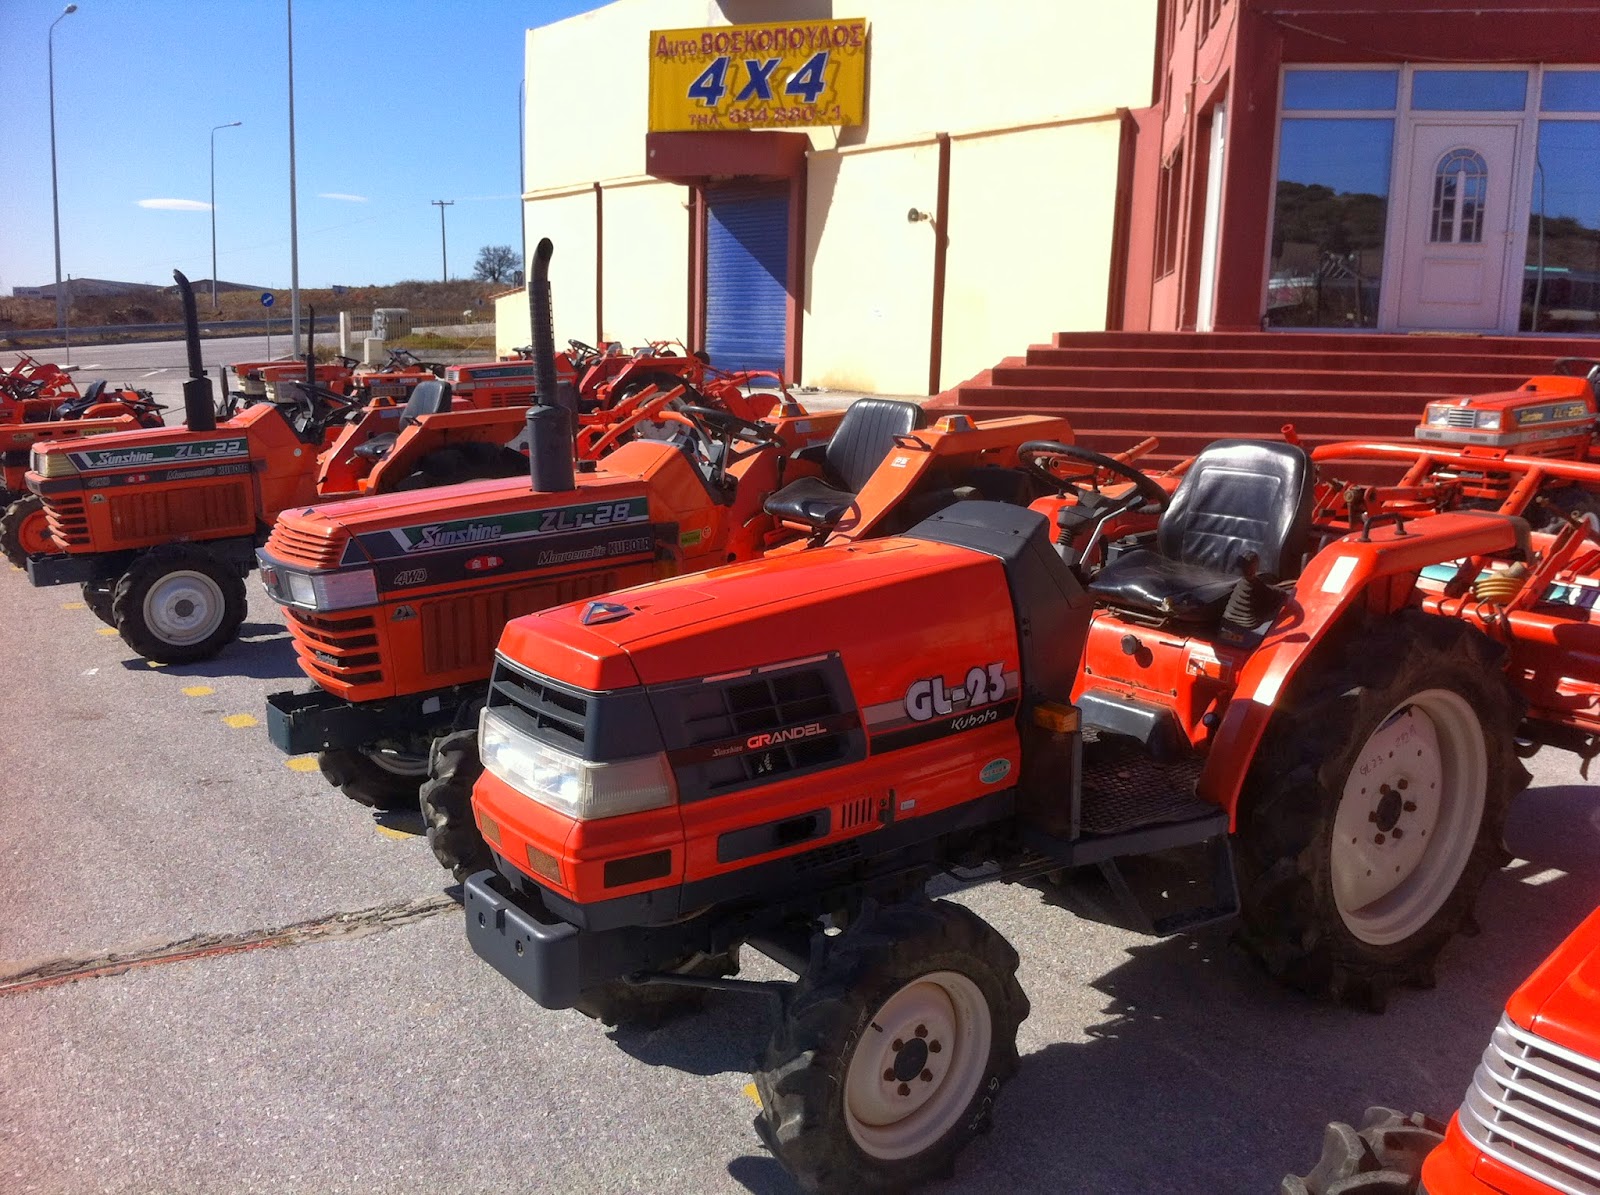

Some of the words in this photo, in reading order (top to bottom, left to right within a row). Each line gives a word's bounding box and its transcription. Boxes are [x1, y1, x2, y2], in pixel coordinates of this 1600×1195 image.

[701, 24, 863, 54] ΒΟΣΚΟΠΟΥΛΟΣ
[94, 451, 154, 466] Sunshine
[412, 523, 502, 550] Sunshine
[607, 537, 652, 556] KUBOTA
[393, 567, 428, 586] 4WD
[904, 660, 1007, 721] GL-23
[950, 709, 998, 731] Kubota
[746, 722, 828, 750] GRANDEL
